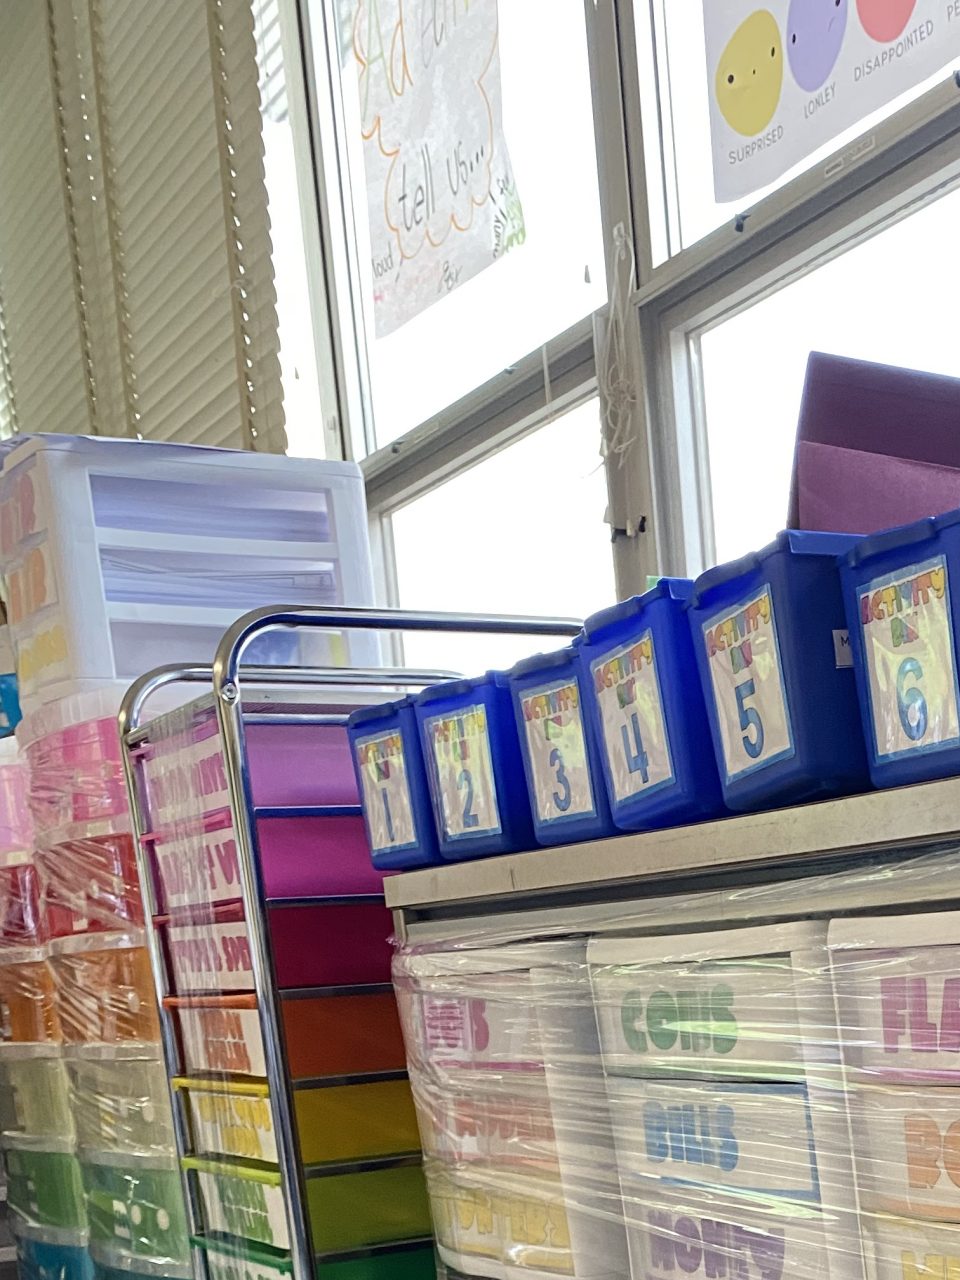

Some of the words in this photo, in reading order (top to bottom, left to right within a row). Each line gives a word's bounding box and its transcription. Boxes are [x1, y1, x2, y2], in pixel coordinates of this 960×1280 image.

[854, 20, 934, 82] DISAPPOINTED
[728, 125, 783, 165] SURPRISED
[399, 143, 435, 232] tell
[706, 595, 771, 658] ACTIVITY
[860, 567, 945, 625] ACTIVITY
[594, 638, 653, 694] ACTIVITY
[734, 678, 764, 758] 5
[896, 657, 928, 741] 6
[550, 748, 571, 811] 3
[620, 712, 649, 784] 4
[381, 787, 395, 842] 1
[457, 768, 479, 829] 2
[642, 1100, 739, 1172] BILLS
